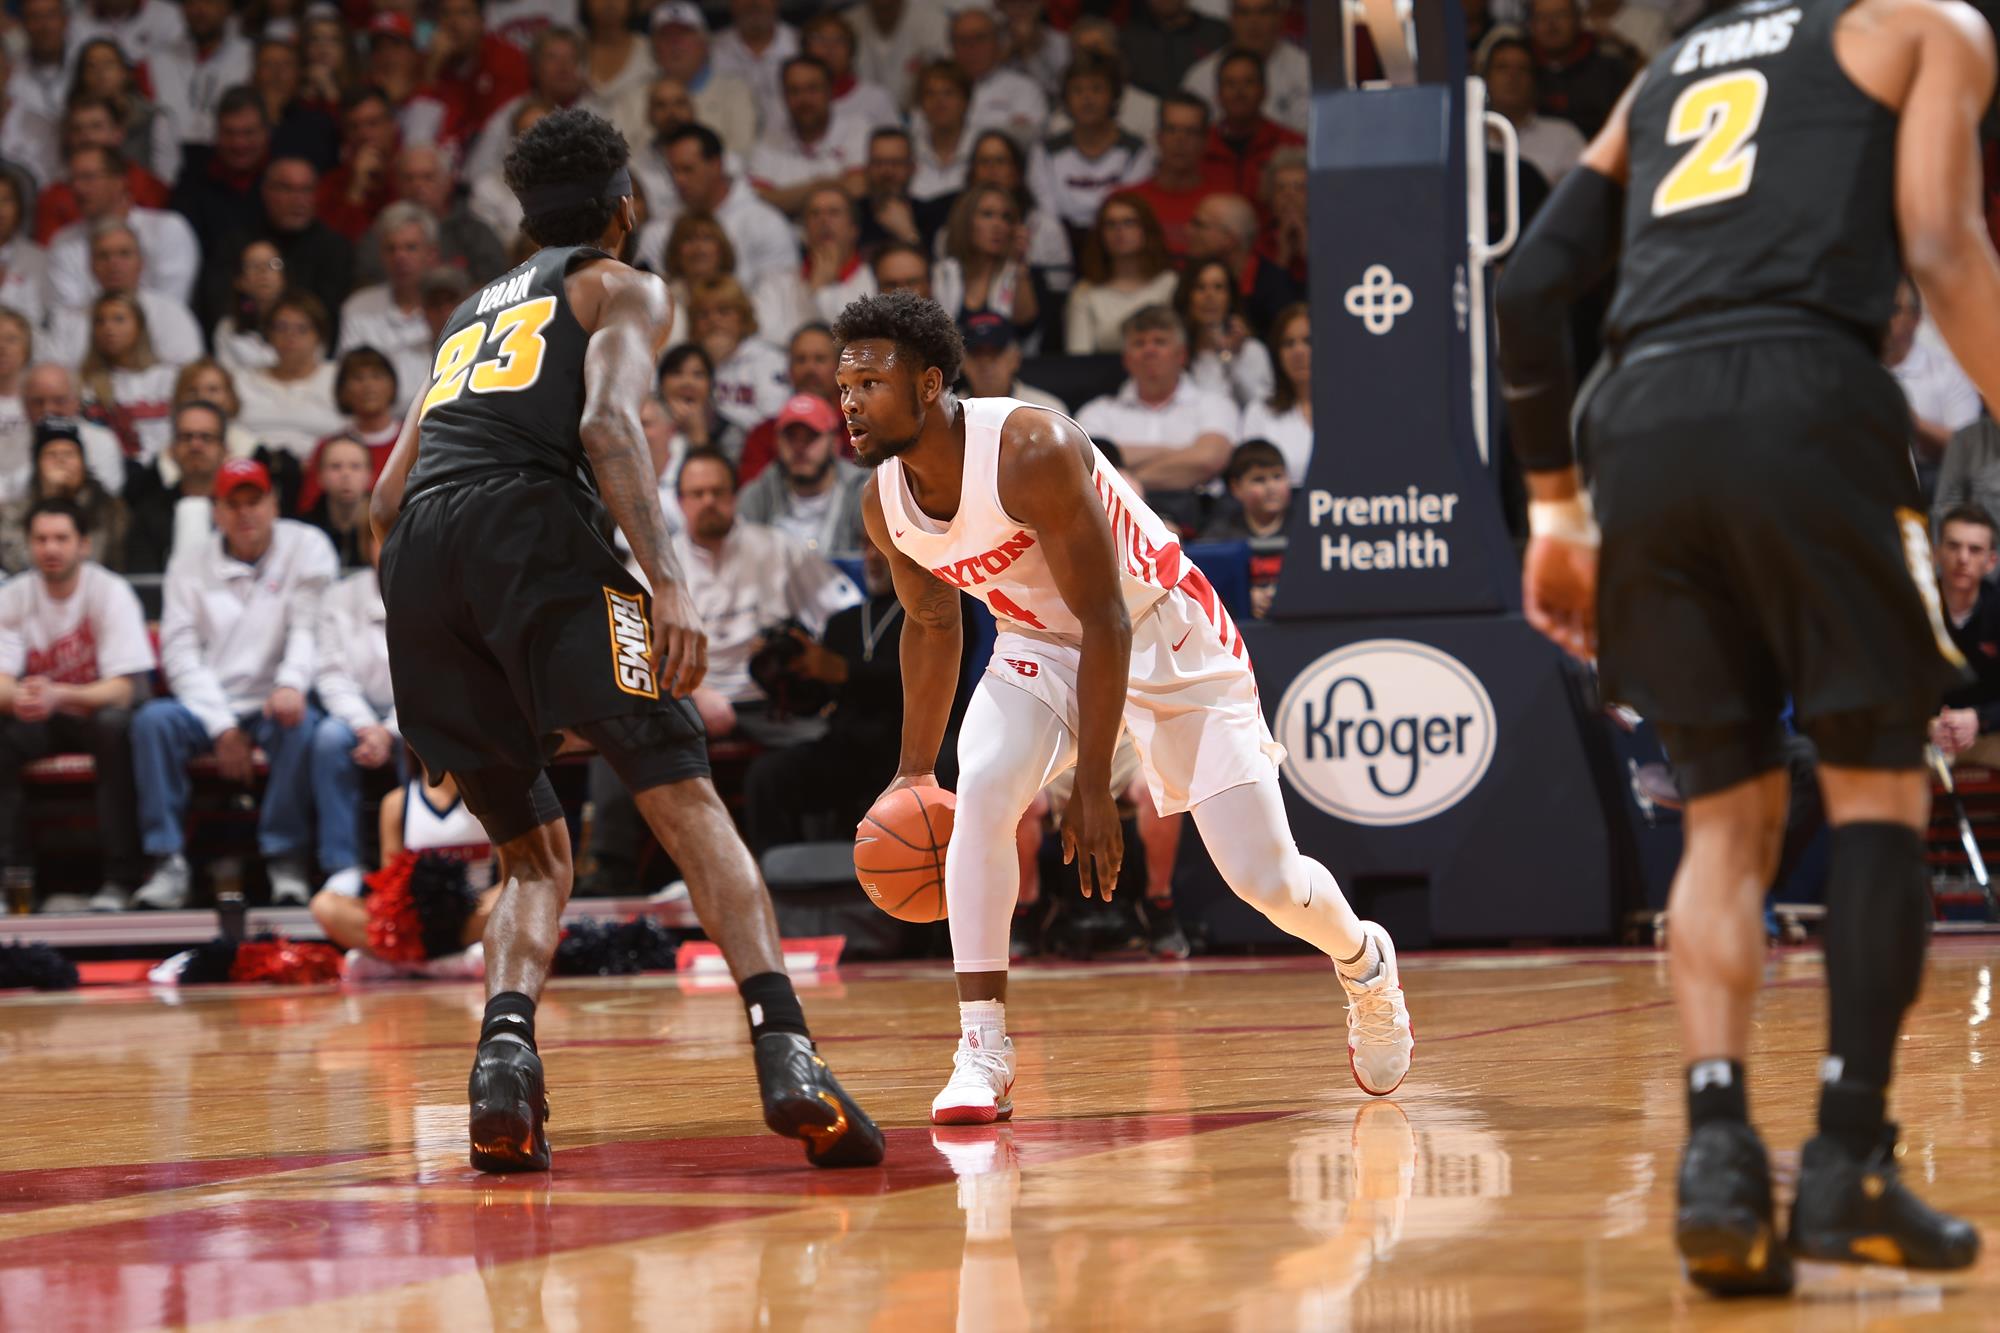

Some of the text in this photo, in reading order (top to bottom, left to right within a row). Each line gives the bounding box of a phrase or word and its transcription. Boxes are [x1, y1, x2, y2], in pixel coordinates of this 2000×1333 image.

[1652, 68, 1768, 218] 2
[475, 265, 537, 316] VANN
[418, 295, 557, 424] 23
[1309, 484, 1459, 527] Premier
[1320, 528, 1449, 571] Health
[609, 593, 653, 693] RAMS
[987, 588, 1047, 630] 4
[1304, 676, 1473, 798] Kroger
